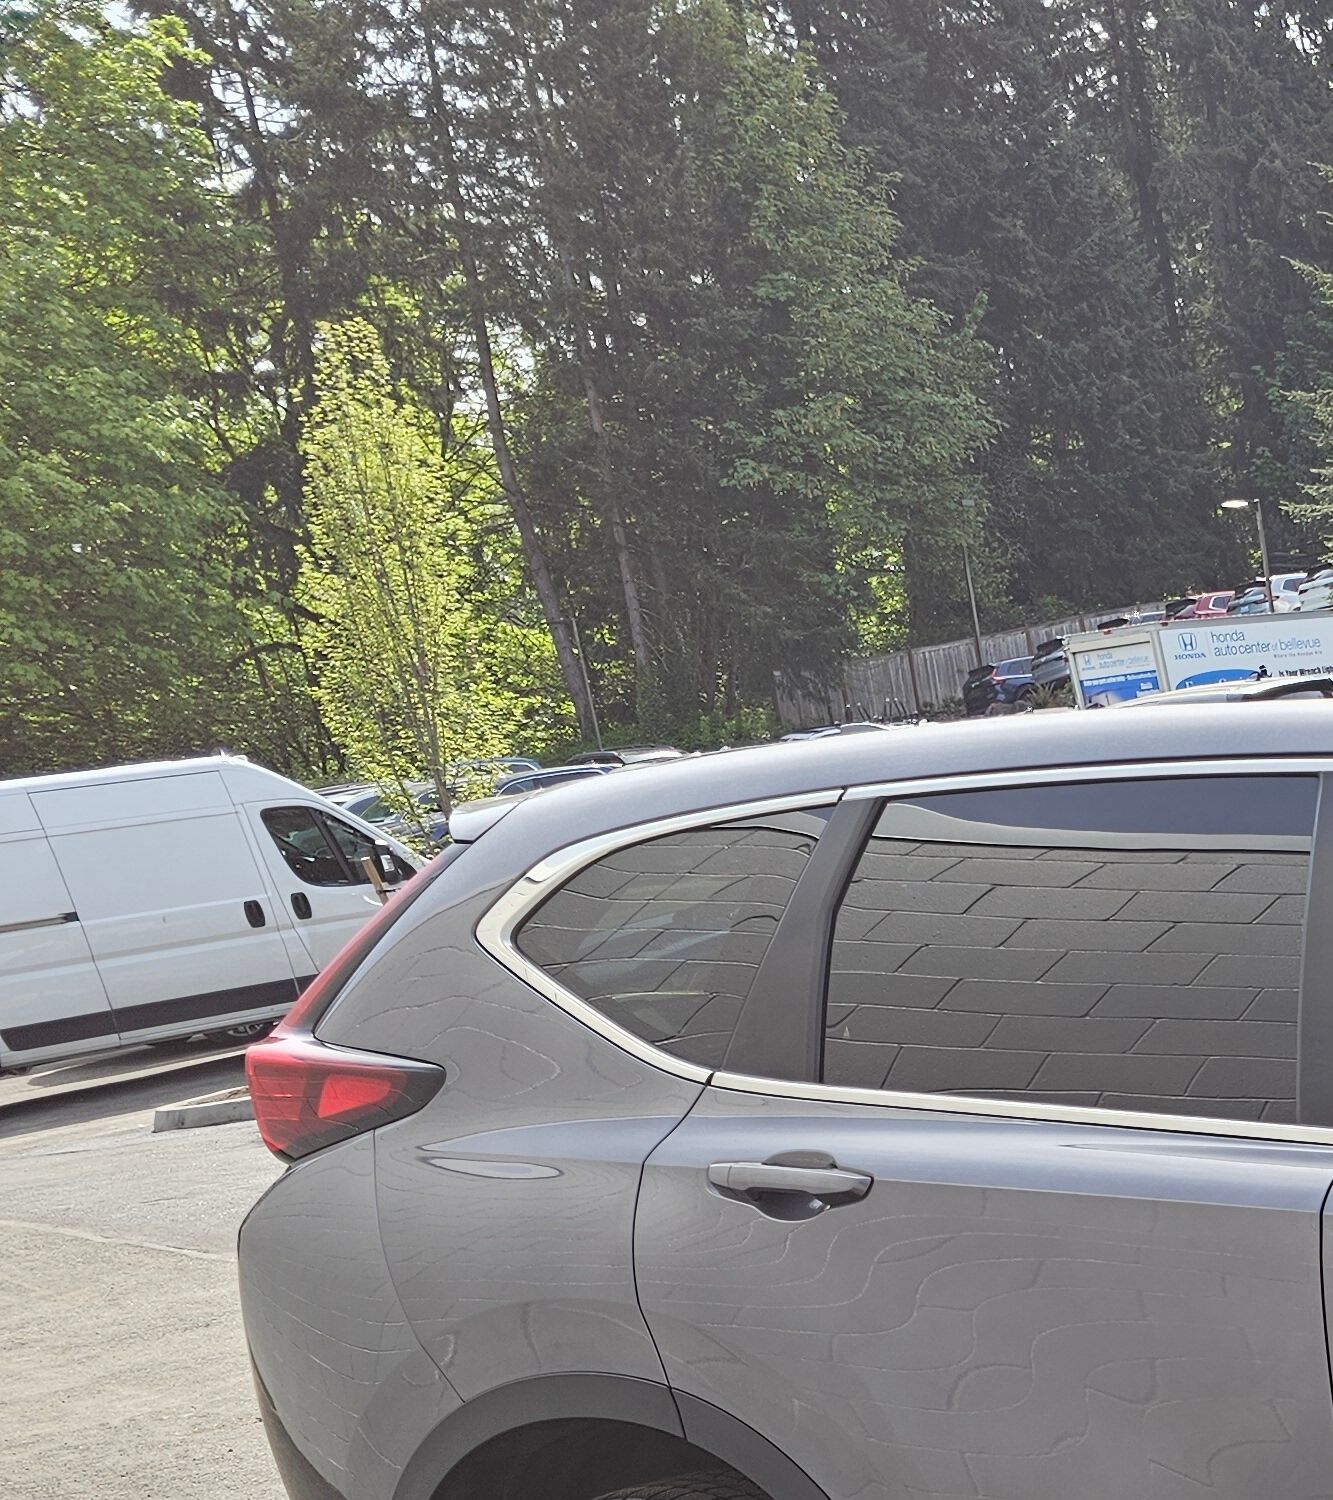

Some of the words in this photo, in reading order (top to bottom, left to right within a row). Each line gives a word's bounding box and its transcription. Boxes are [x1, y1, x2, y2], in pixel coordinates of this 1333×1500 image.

[1210, 629, 1246, 643] honda
[1279, 637, 1321, 651] bellevue
[1174, 652, 1207, 660] HONDA
